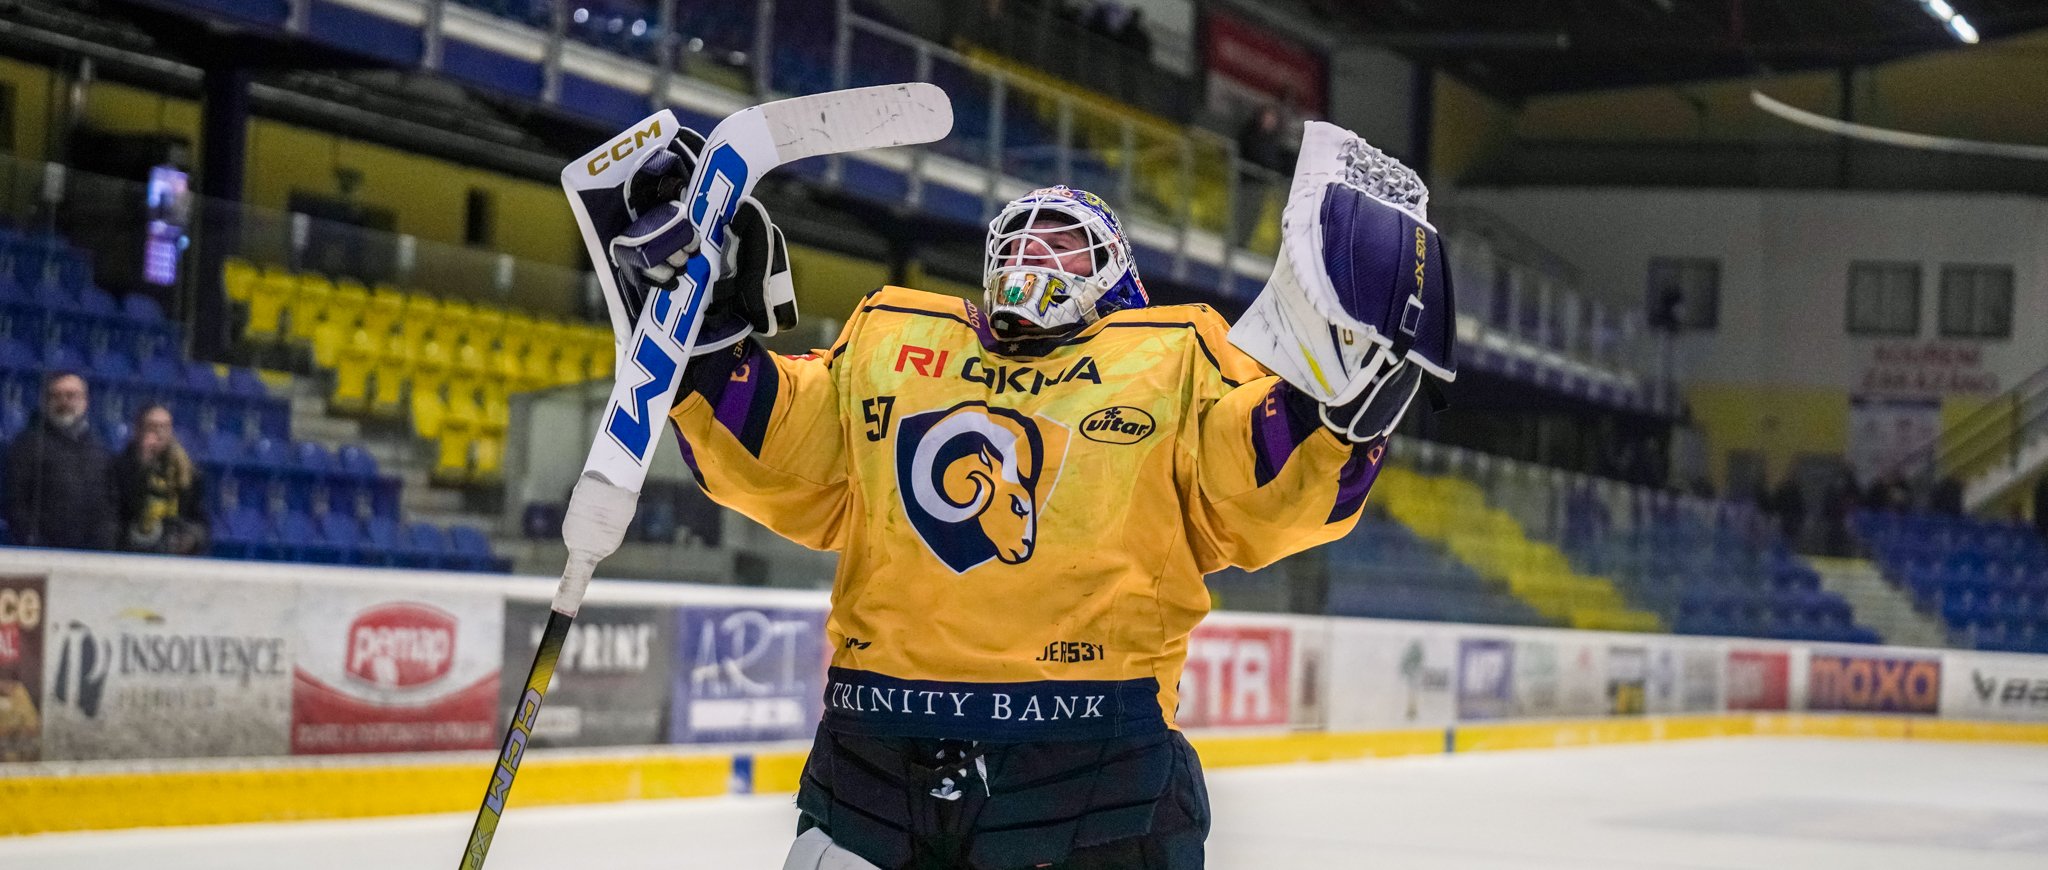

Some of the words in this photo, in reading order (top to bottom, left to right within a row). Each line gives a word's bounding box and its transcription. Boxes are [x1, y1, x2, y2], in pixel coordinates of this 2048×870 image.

[587, 120, 662, 176] CCM
[605, 140, 748, 466] CCM
[894, 344, 949, 378] RI
[861, 395, 897, 442] 57
[1086, 409, 1151, 436] vitar
[691, 610, 811, 694] ART
[832, 682, 974, 717] TRINITY
[991, 693, 1105, 721] BANK
[486, 687, 543, 817] CCM
